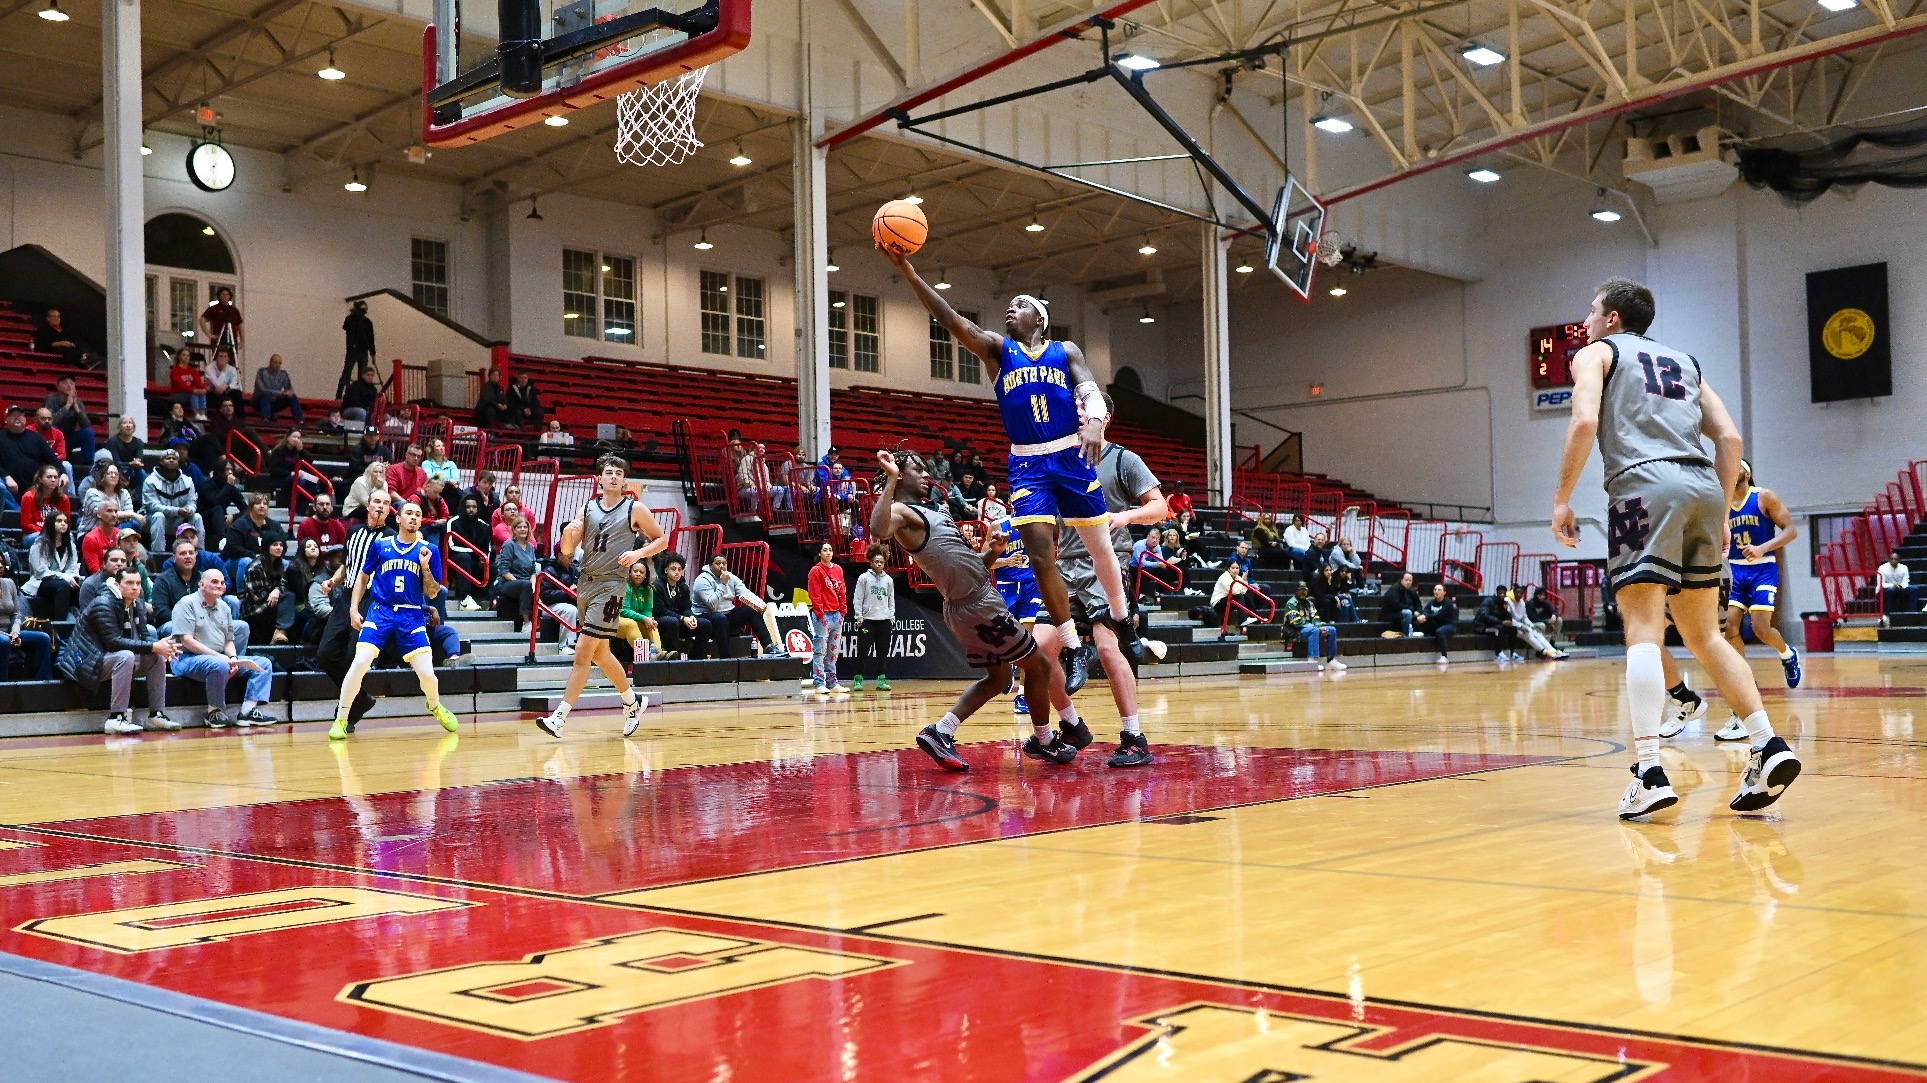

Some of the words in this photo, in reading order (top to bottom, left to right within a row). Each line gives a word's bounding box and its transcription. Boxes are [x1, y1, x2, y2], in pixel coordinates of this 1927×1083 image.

[1541, 338, 1553, 353] 14
[1540, 362, 1547, 375] 2
[1637, 351, 1686, 401] 12
[1003, 366, 1038, 395] NORTH
[1038, 366, 1068, 390] PARK
[1537, 391, 1572, 406] PEP
[1030, 394, 1050, 422] 11
[593, 533, 609, 552] 11
[395, 576, 404, 592] 5
